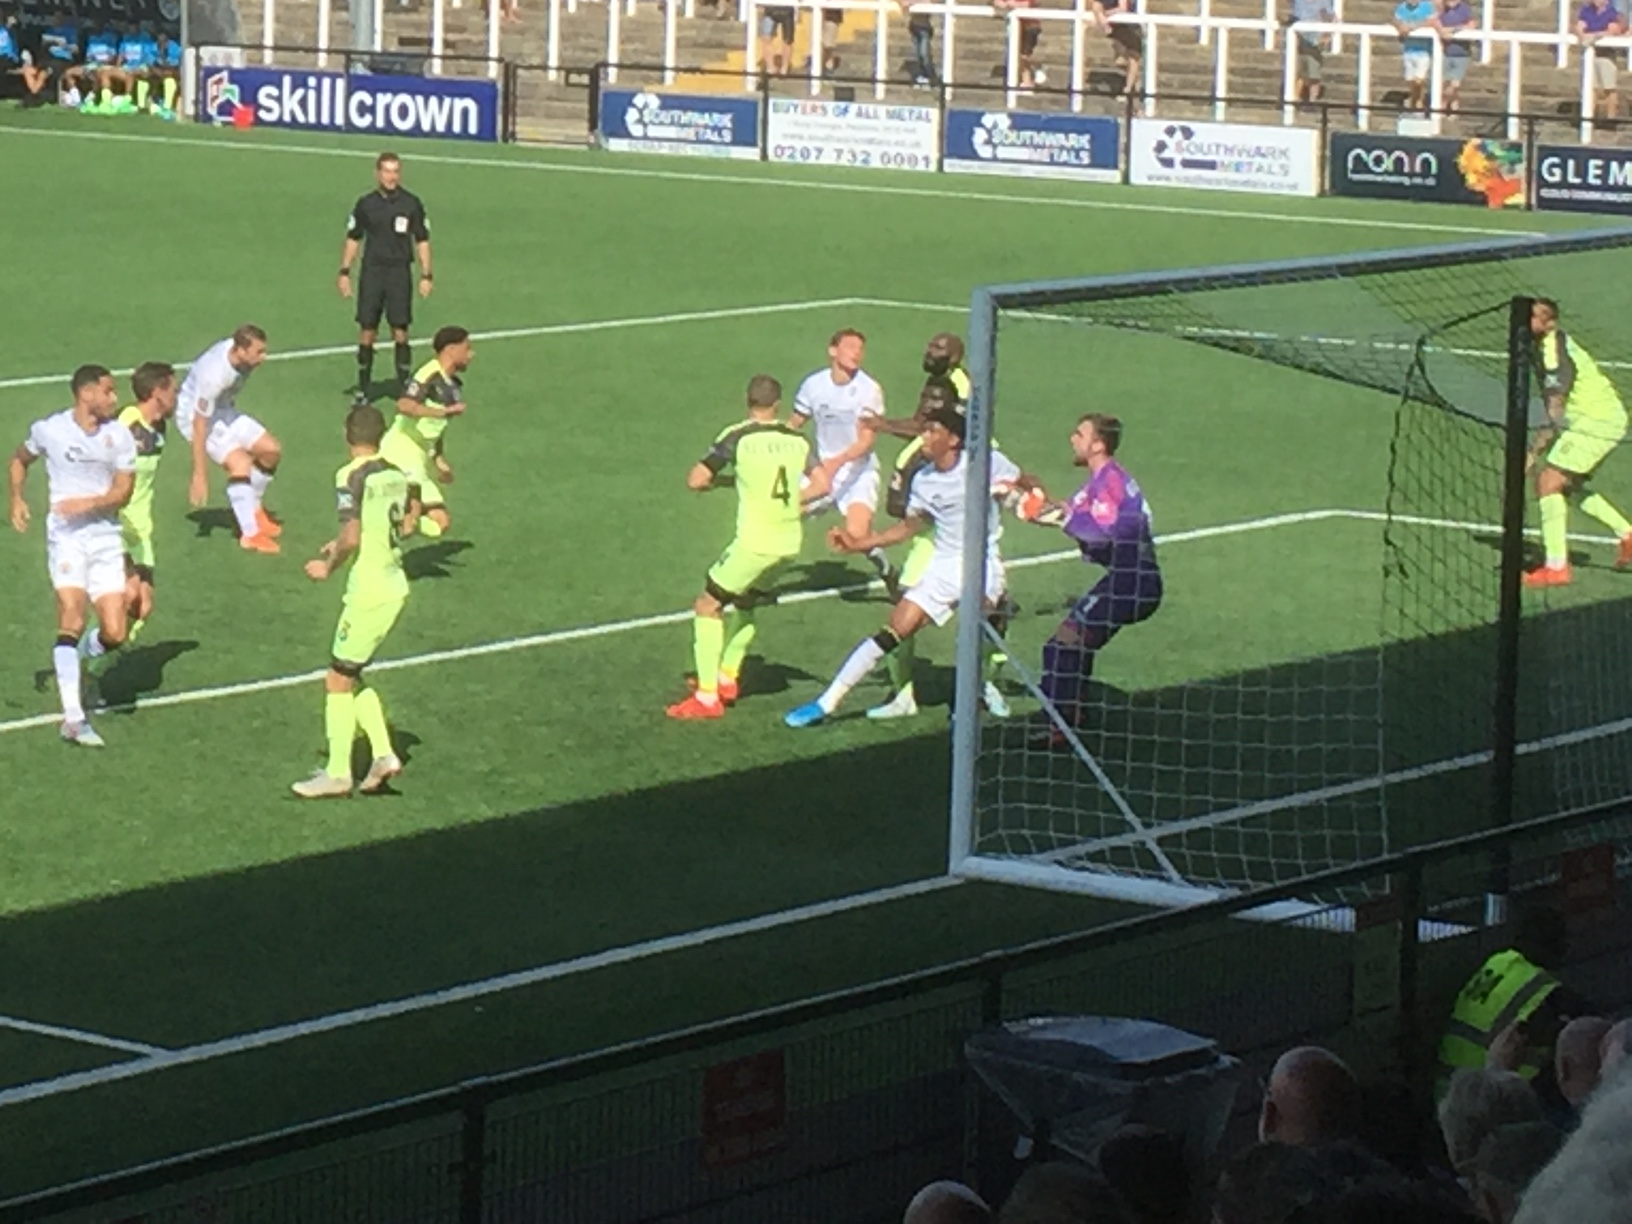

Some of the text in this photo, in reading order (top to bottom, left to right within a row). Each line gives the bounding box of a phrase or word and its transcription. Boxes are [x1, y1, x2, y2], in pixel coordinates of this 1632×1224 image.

[257, 74, 479, 135] skillcrown
[855, 105, 881, 120] ALL
[774, 144, 824, 161] 0207
[834, 148, 872, 165] 732
[1175, 140, 1290, 160] SOUTHWARK
[1218, 159, 1290, 177] METALS
[771, 465, 790, 507] 4
